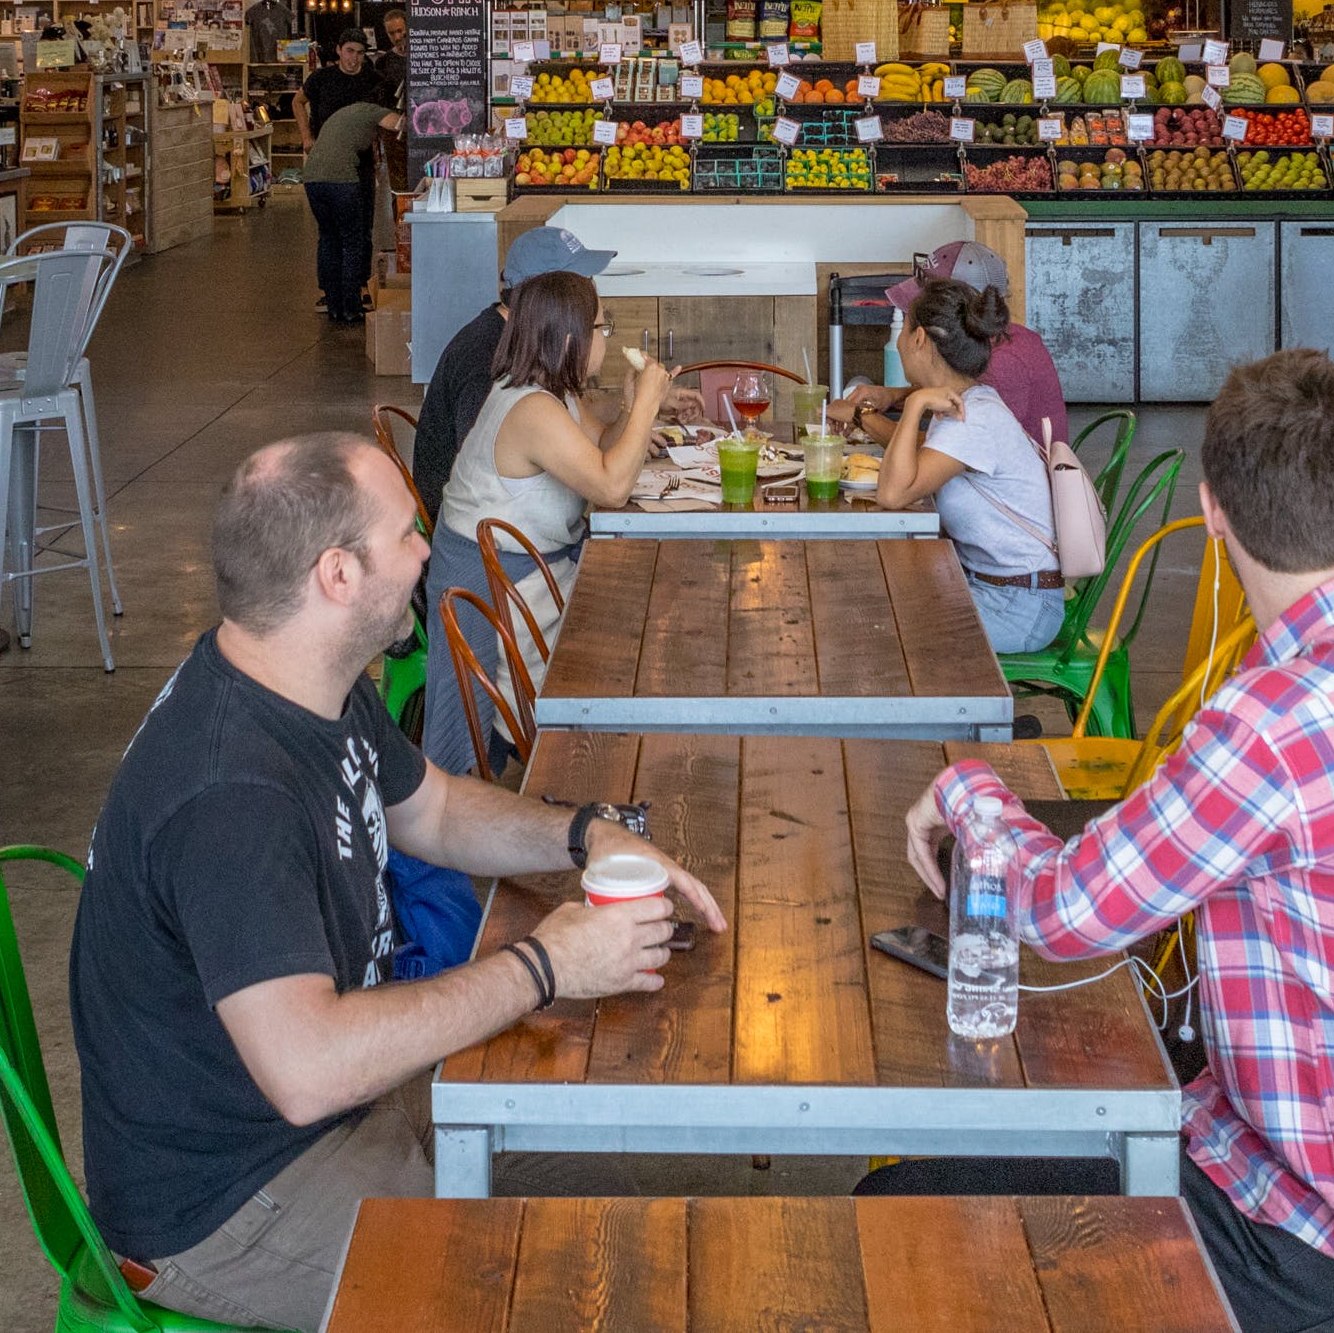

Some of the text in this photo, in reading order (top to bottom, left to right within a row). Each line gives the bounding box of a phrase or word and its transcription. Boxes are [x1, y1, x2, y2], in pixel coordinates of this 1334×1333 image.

[411, 6, 479, 17] HUDSON RANCH
[334, 795, 353, 861] THE
